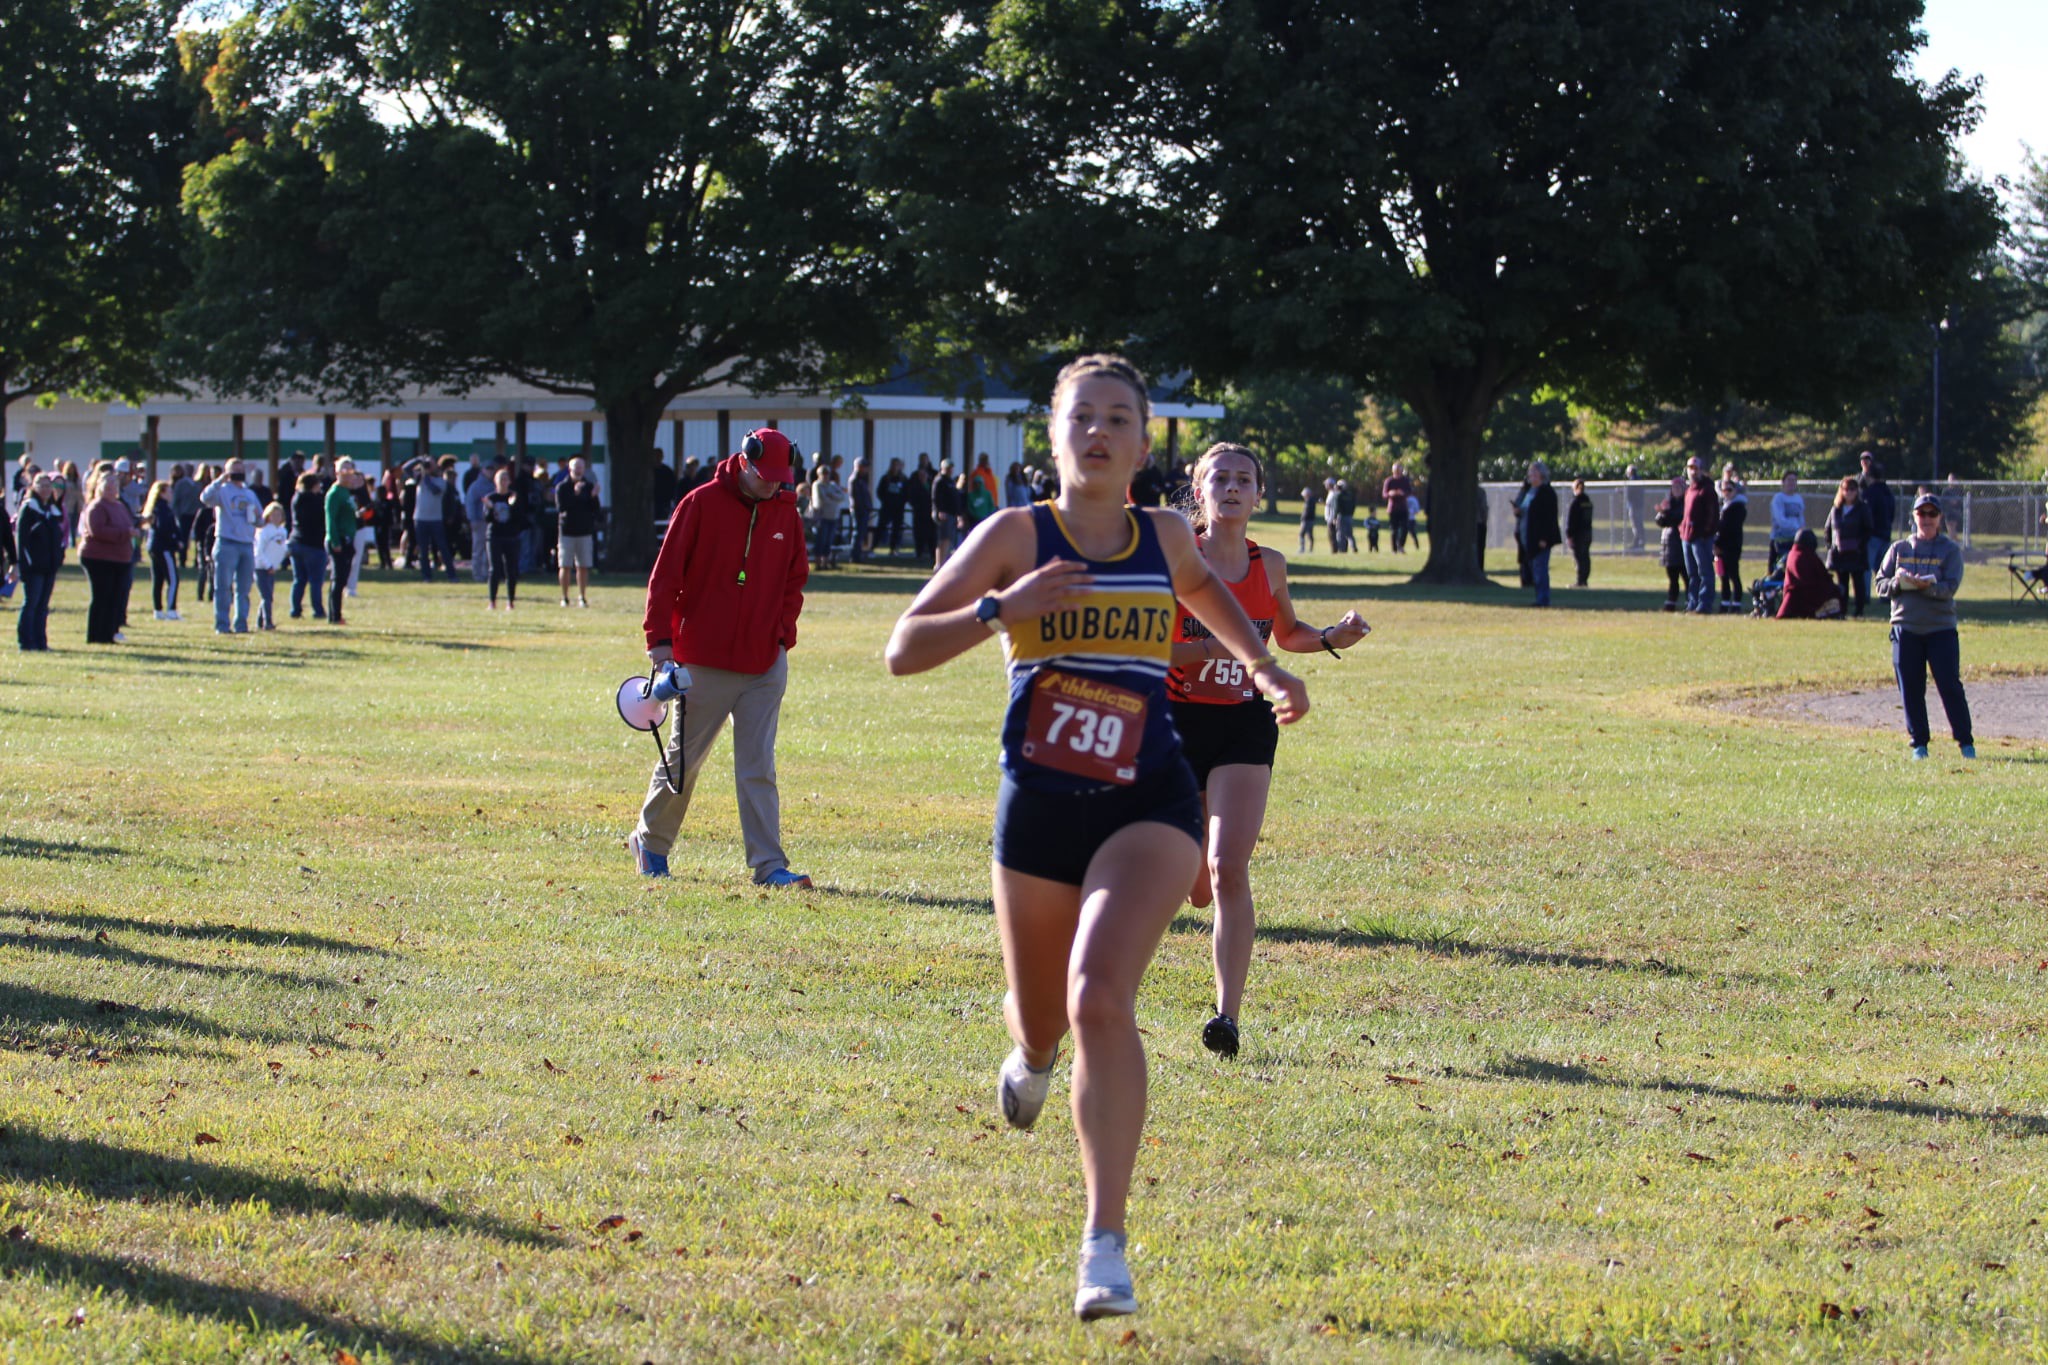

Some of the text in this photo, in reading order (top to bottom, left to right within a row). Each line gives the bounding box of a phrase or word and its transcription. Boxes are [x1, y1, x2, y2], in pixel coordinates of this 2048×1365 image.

[1041, 606, 1170, 642] BOBCATS
[1199, 658, 1243, 686] 755
[1046, 702, 1123, 758] 739
